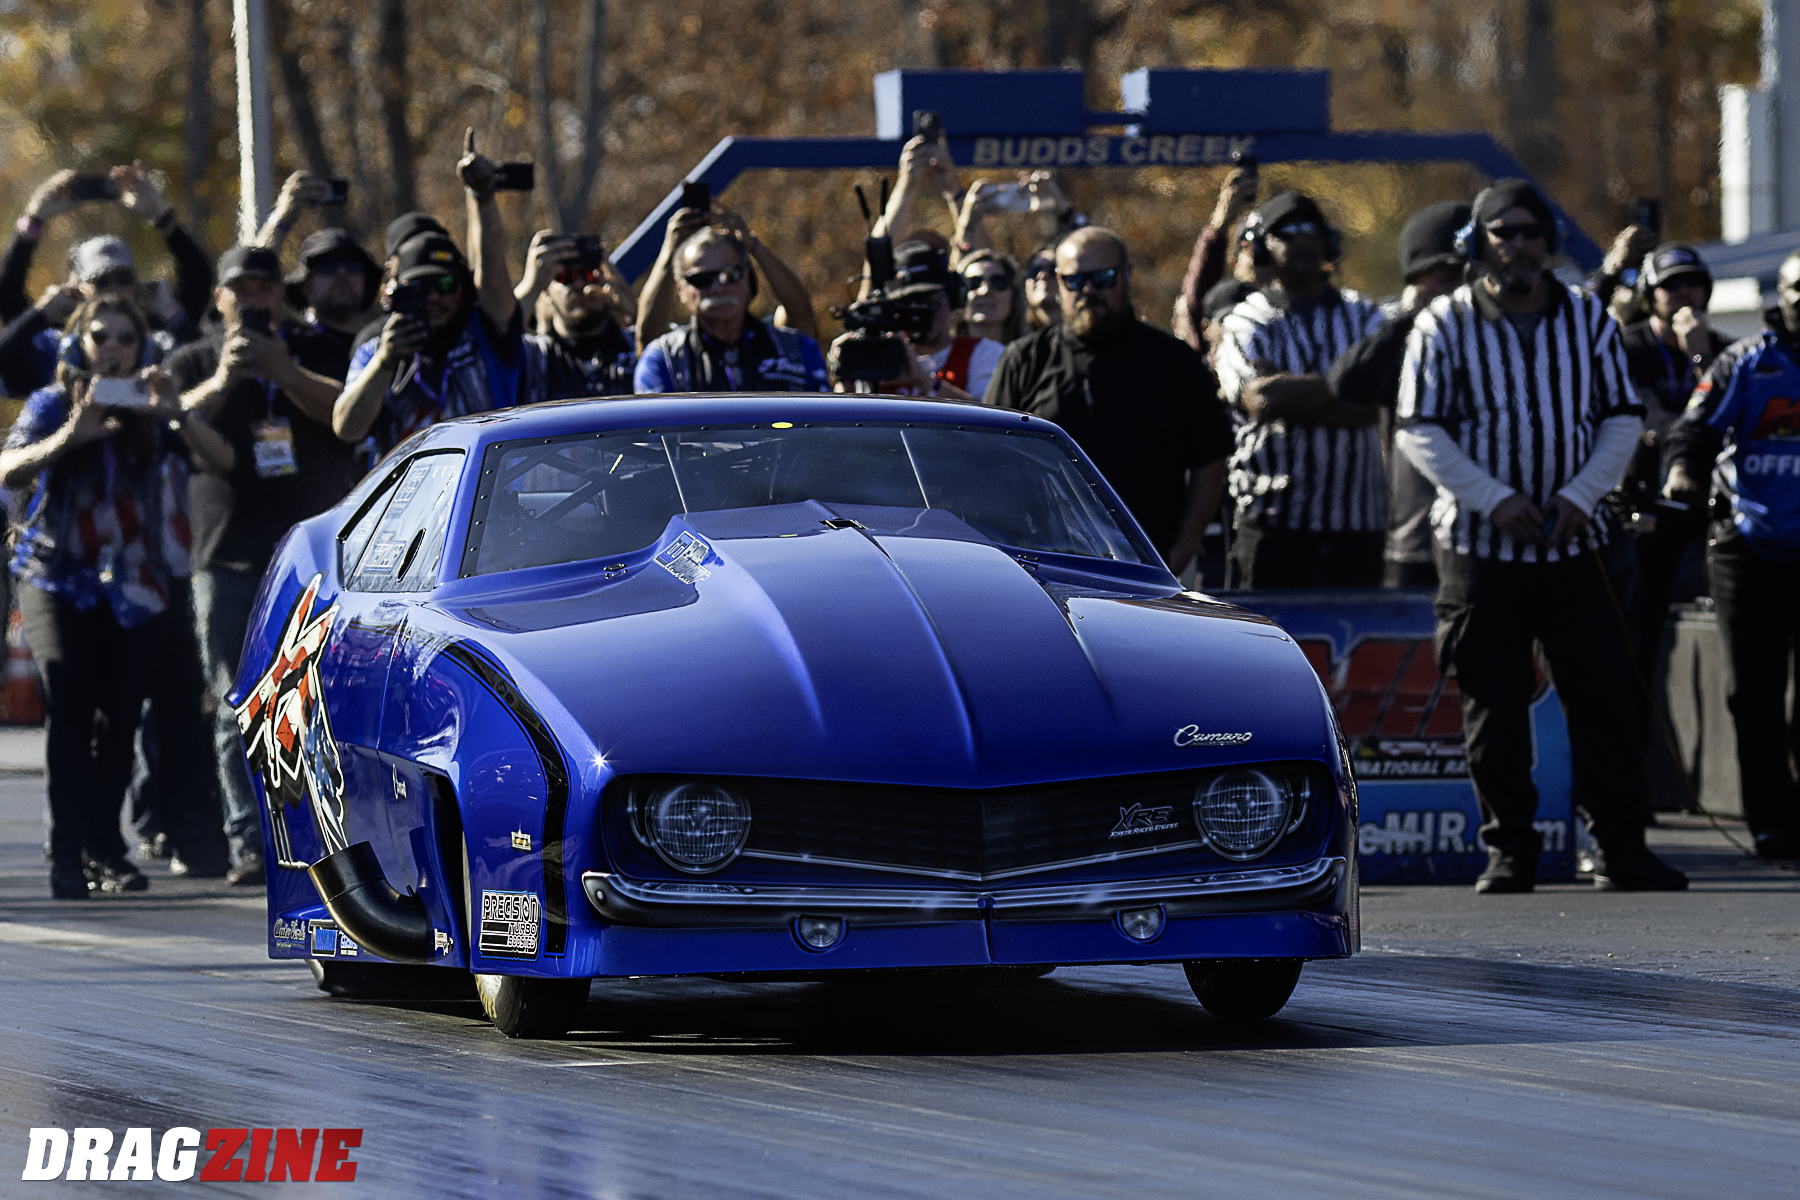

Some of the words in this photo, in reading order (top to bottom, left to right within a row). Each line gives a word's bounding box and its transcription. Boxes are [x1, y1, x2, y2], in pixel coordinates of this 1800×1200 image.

[973, 136, 1110, 165] BUDDS
[1121, 135, 1254, 164] CREEK
[1173, 724, 1253, 747] Camaro
[482, 894, 538, 922] PRECISION
[508, 922, 537, 936] TURBO
